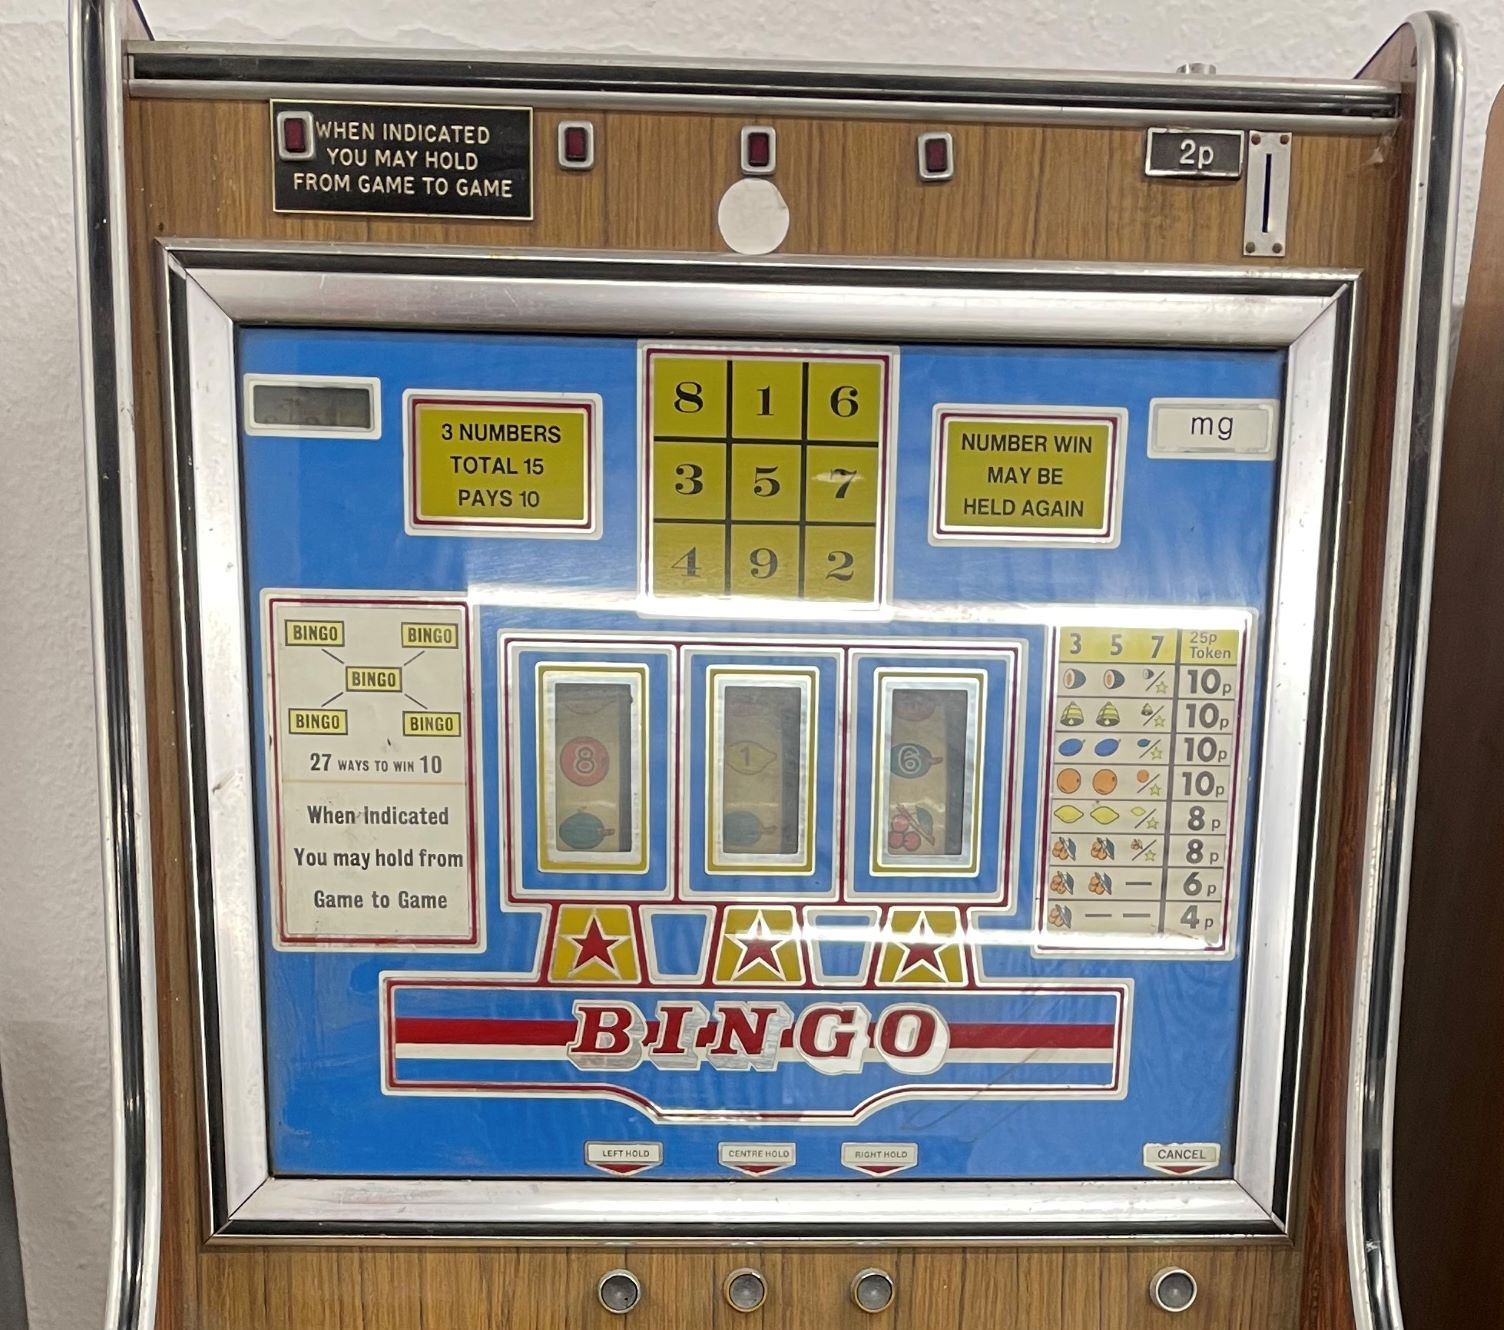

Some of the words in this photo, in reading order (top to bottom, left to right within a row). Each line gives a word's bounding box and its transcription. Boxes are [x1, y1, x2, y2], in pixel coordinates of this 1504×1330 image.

[315, 121, 375, 141] WHEN
[383, 123, 490, 144] INDICATED
[327, 148, 367, 167] YOU
[375, 150, 418, 169] MAY
[425, 152, 478, 171] HOLD
[1179, 139, 1214, 169] 2p
[294, 173, 350, 192] FROM
[358, 175, 415, 195] GAME
[422, 177, 448, 195] TO
[456, 179, 512, 198] GAME
[674, 381, 704, 413] 8
[756, 385, 774, 416] 1
[830, 385, 859, 417] 6
[441, 424, 453, 440] 3
[460, 424, 561, 444] NUMBERS
[1191, 415, 1234, 440] mg
[961, 433, 1047, 453] NUMBER
[1053, 435, 1092, 454] WIN
[450, 456, 518, 475] TOTAL
[524, 458, 544, 475] 15
[987, 466, 1032, 485] MAY
[1037, 468, 1063, 485] BE
[675, 464, 703, 495] 3
[753, 466, 781, 497] 5
[830, 468, 857, 499] 7
[458, 489, 513, 507] PAYS
[520, 490, 540, 508] 10
[963, 498, 1015, 517] HELD
[1021, 500, 1084, 518] AGAIN
[671, 547, 701, 577] 4
[750, 548, 778, 579] 9
[825, 551, 854, 581] 2
[293, 625, 338, 641] BINGO
[407, 627, 451, 644] BINGO
[1189, 631, 1217, 645] 25p
[1069, 633, 1082, 655] 3
[1110, 634, 1123, 656] 5
[1151, 635, 1165, 659] 7
[1189, 646, 1231, 659] Token
[352, 671, 396, 687] BINGO
[1187, 668, 1232, 696] 10p
[295, 714, 340, 729] BINGO
[410, 716, 453, 732] BINGO
[1186, 702, 1229, 731] 10p
[575, 745, 596, 774] 8
[740, 745, 752, 767] 1
[898, 745, 922, 774] 6
[1184, 736, 1228, 763] 10p
[310, 753, 332, 772] 27
[338, 759, 369, 772] WAYS
[375, 760, 388, 772] TO
[393, 761, 414, 772] WIN
[420, 755, 442, 774] 10
[1182, 770, 1225, 798] 10p
[307, 805, 356, 824] When
[364, 806, 449, 825] Indicated
[294, 848, 327, 866] You
[333, 851, 370, 870] may
[375, 849, 413, 867] hold
[419, 849, 463, 868] from
[314, 890, 364, 908] Game
[372, 891, 390, 908] to
[399, 891, 448, 909] Game
[567, 1000, 950, 1075] BINGO
[602, 1150, 624, 1158] LEFT
[626, 1150, 650, 1158] HOLD
[728, 1150, 763, 1159] CENTRE
[855, 1151, 882, 1159] RIGHT
[883, 1151, 908, 1159] HOLD
[1157, 1149, 1207, 1160] CANCEL
